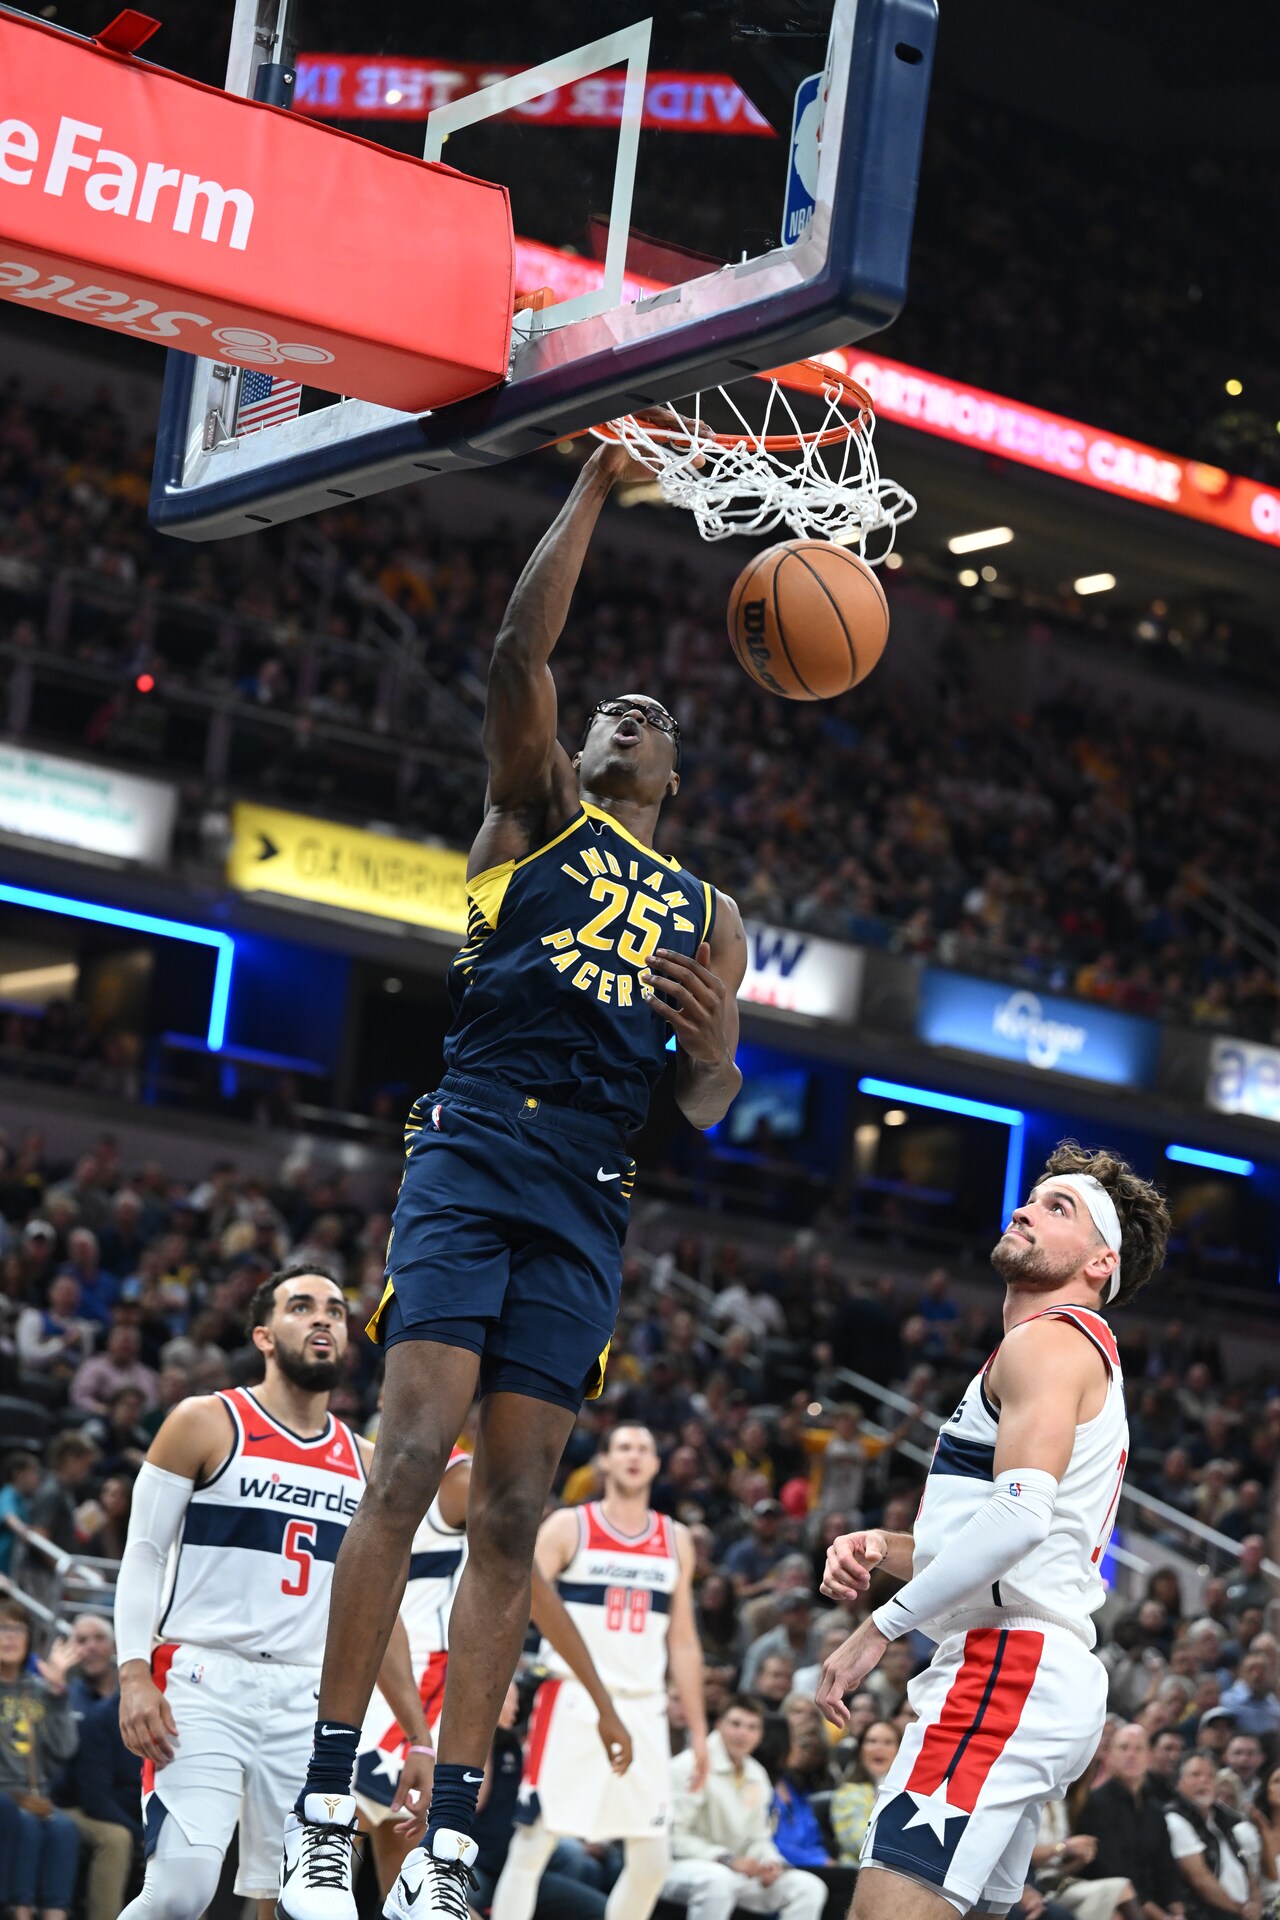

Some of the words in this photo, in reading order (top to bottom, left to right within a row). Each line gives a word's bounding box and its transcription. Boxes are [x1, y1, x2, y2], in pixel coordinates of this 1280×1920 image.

[1086, 440, 1183, 503] CARE
[560, 846, 696, 934] INDIANA
[576, 876, 670, 969] 25
[239, 1472, 360, 1518] wizards
[280, 1518, 318, 1597] 5
[604, 1585, 653, 1634] 88
